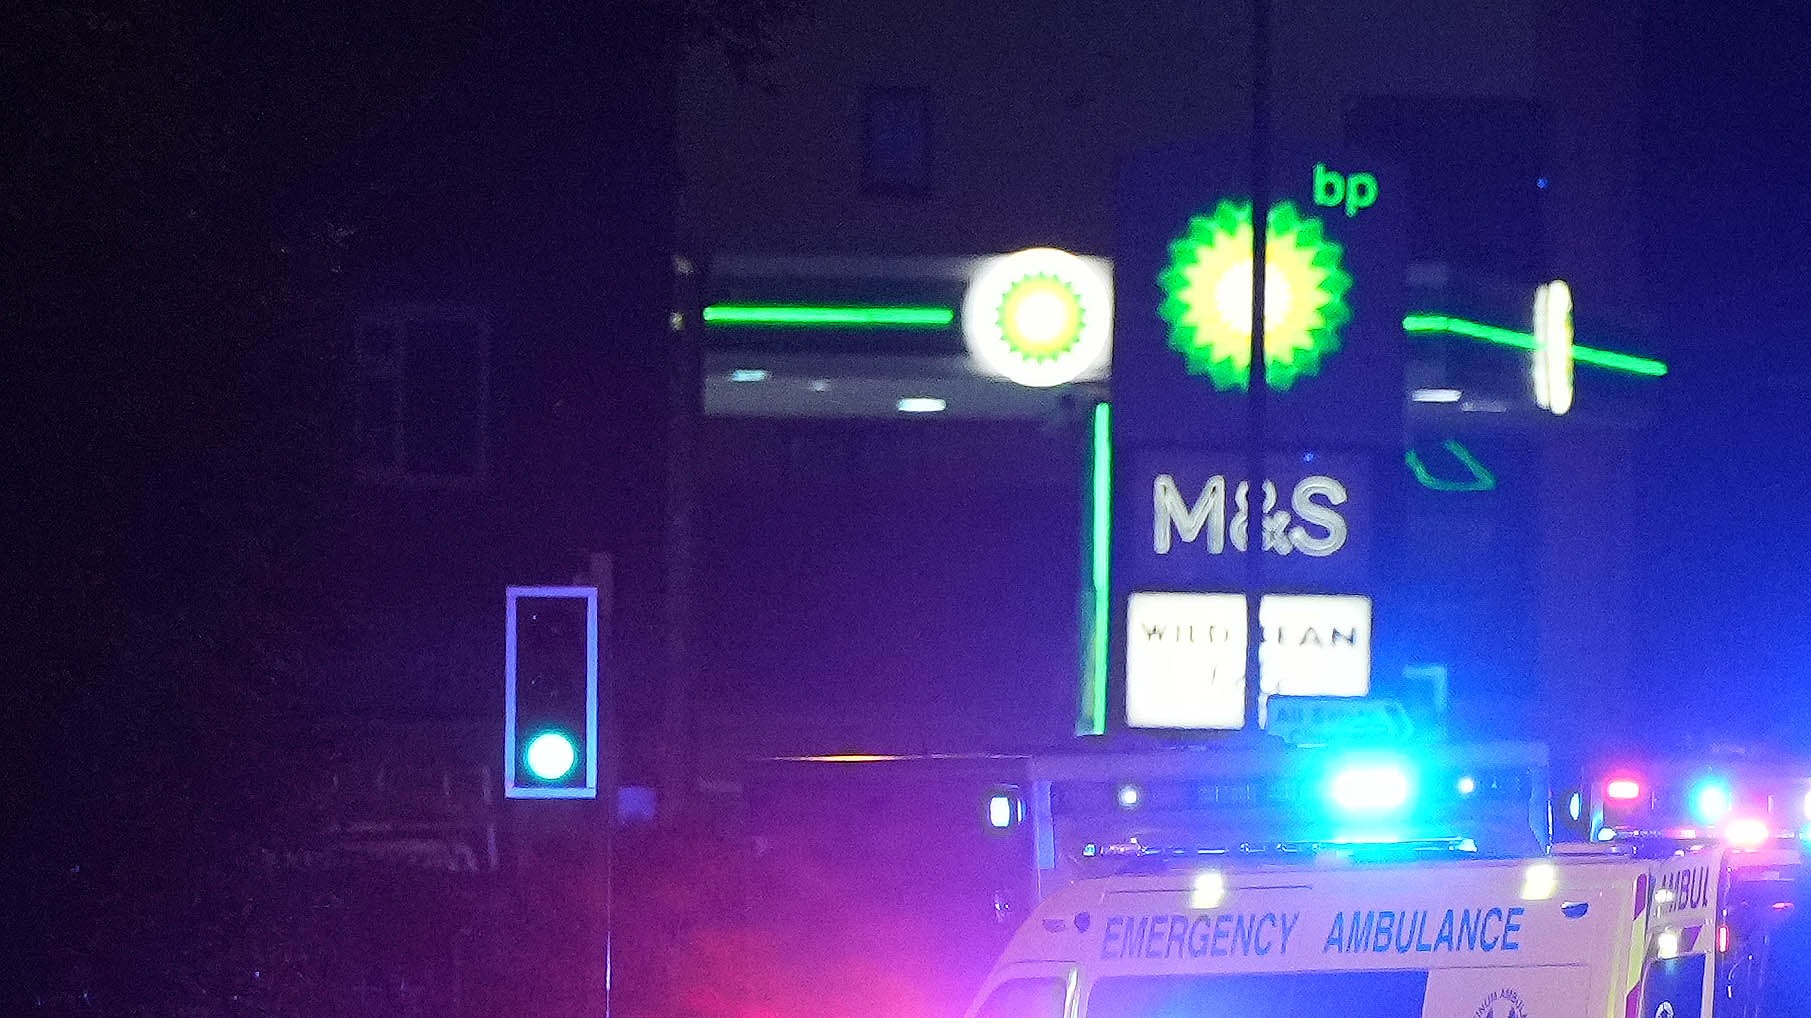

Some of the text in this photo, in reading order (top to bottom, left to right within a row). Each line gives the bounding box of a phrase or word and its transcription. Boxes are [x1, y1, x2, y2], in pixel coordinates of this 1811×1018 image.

[1313, 164, 1378, 216] bp
[1153, 474, 1347, 557] M&S
[1101, 906, 1525, 959] EMERGENCY AMBULANCE
